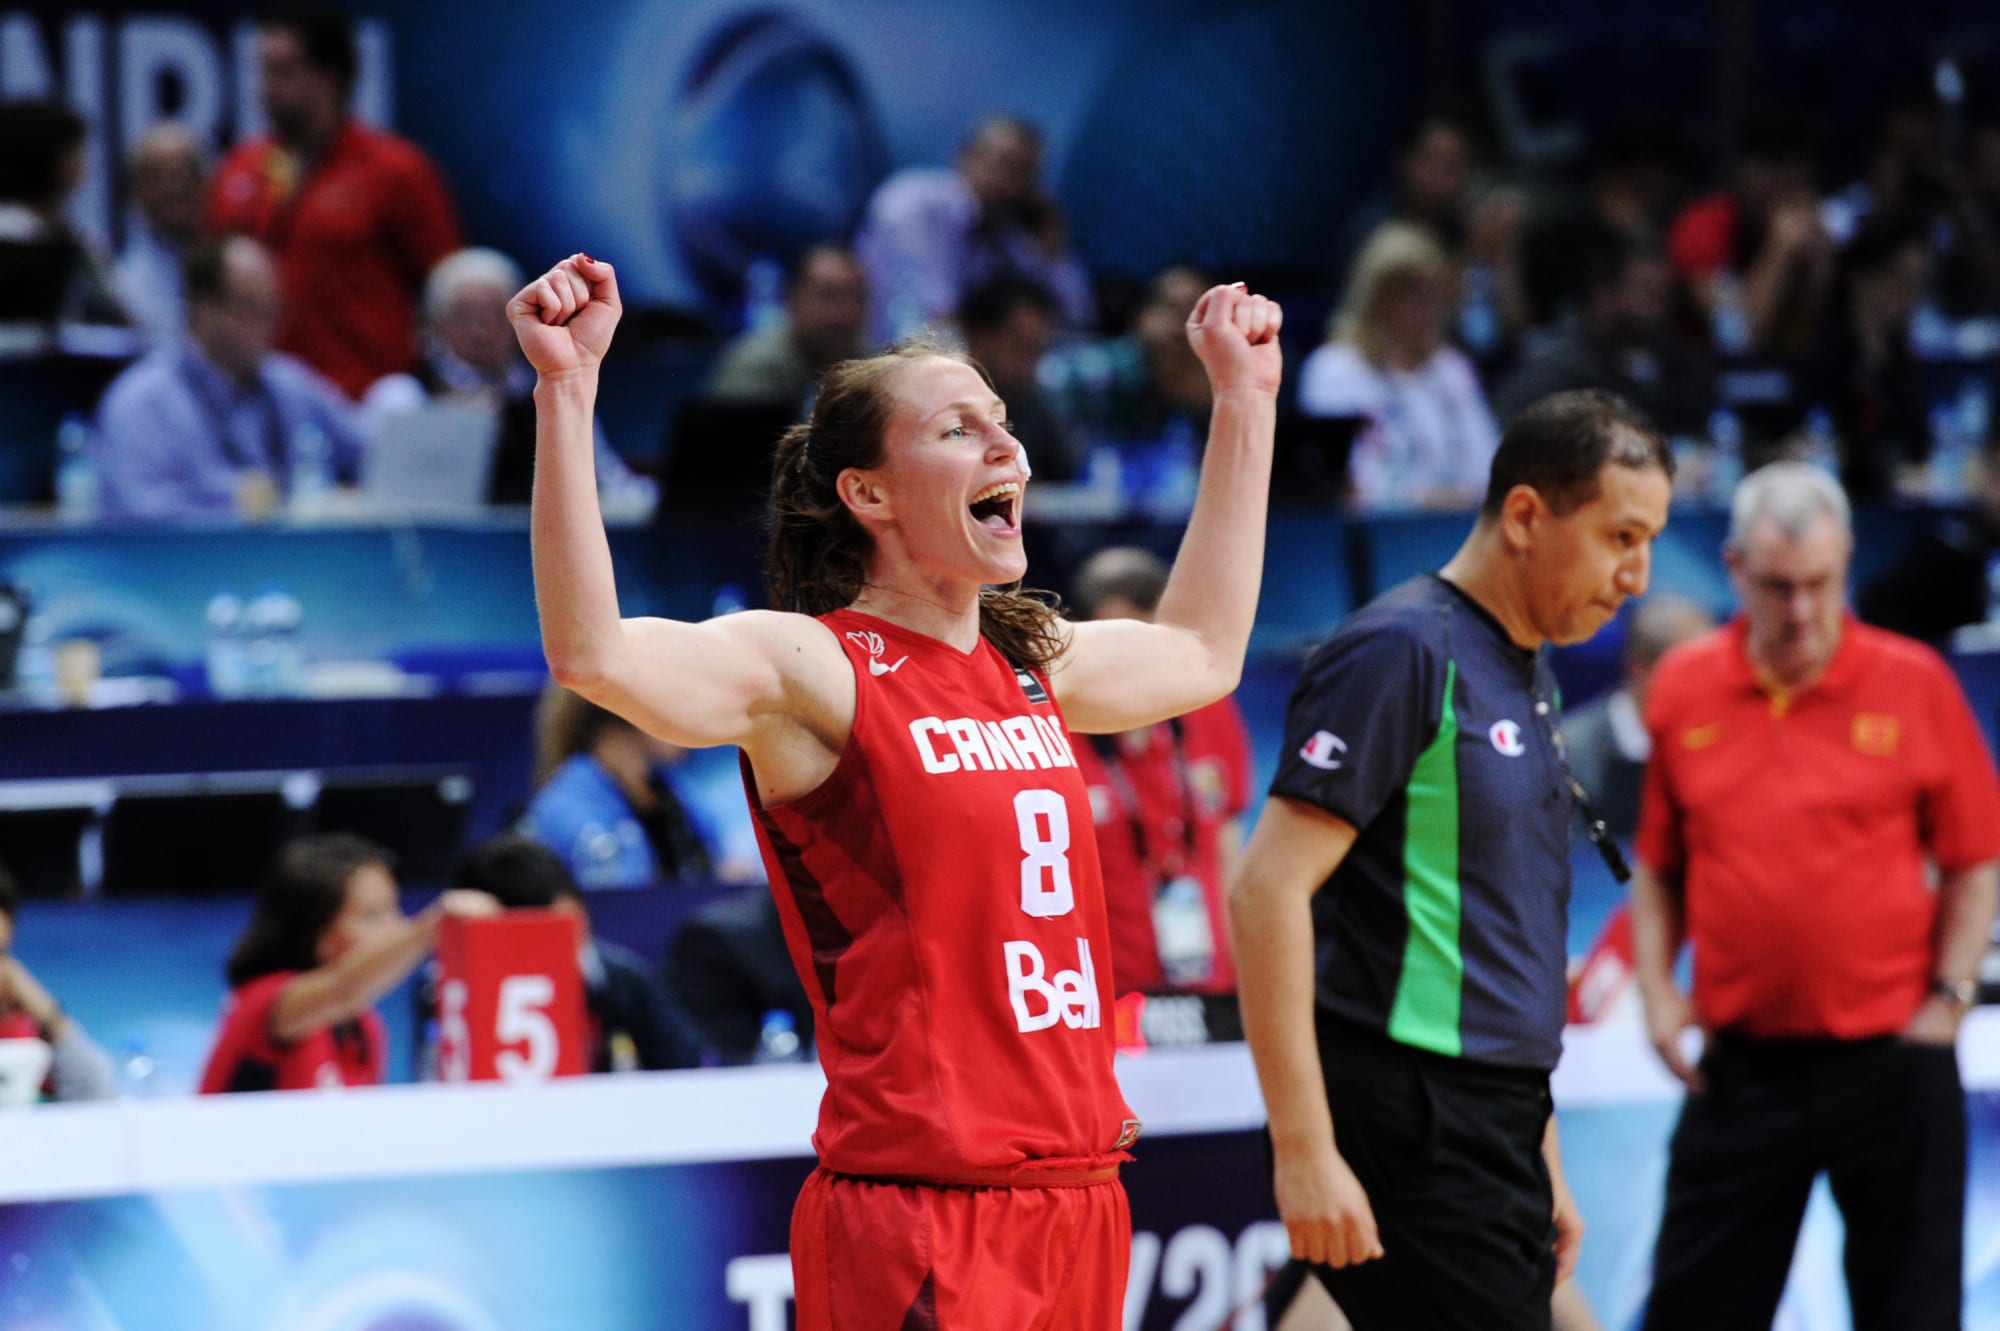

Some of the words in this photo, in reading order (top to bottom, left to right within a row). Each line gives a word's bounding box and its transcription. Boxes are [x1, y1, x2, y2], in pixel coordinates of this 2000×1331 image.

[908, 715, 1078, 774] CANAD
[1013, 789, 1075, 916] 8
[495, 974, 559, 1081] 5
[1003, 937, 1100, 1033] Bell
